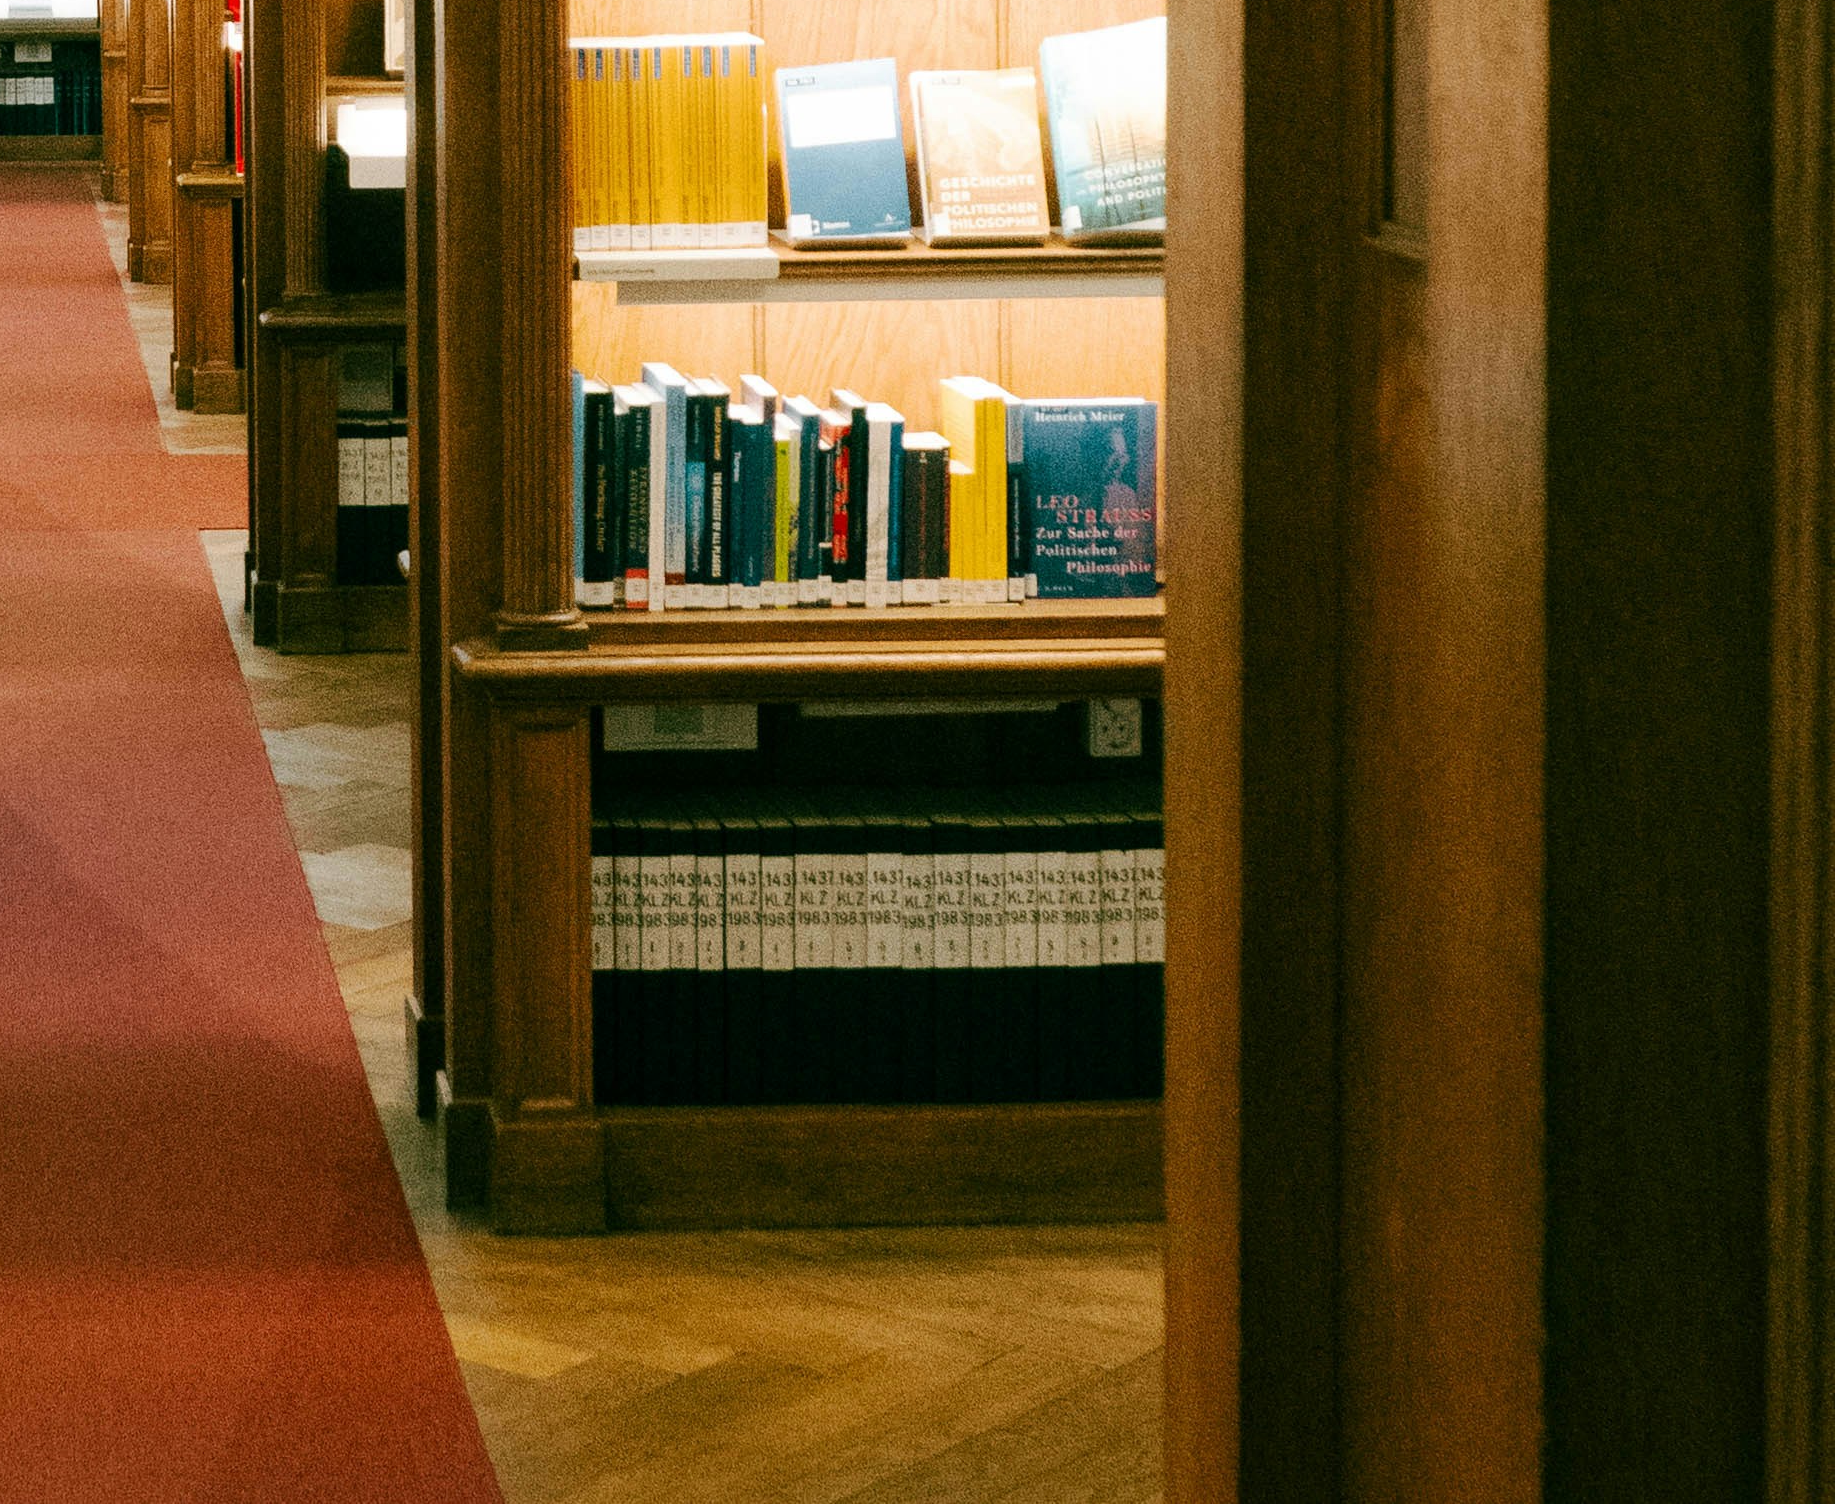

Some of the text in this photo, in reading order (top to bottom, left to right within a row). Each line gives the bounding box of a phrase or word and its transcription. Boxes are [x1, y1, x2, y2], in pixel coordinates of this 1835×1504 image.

[939, 174, 1036, 189] GESCHICHTE
[940, 191, 972, 203] DER
[1097, 193, 1124, 207] AND
[1034, 411, 1125, 423] Heinrich Meier
[593, 479, 607, 519] Pecking
[1035, 494, 1080, 509] LEO
[1055, 508, 1153, 524] STRAUSS
[711, 472, 722, 578] THE GREATEST OF ALL PLAGUES
[1035, 525, 1139, 540] Zur Sache der
[1035, 544, 1118, 557] Politischen
[1065, 560, 1153, 577] Philosophie
[730, 889, 757, 905] KLZ
[765, 891, 793, 907] KLZ
[799, 889, 828, 905] KLZ
[836, 891, 865, 906] KLZ
[870, 890, 899, 905] KLZ
[904, 893, 933, 910] KLZ
[937, 890, 965, 906] KLZ
[972, 891, 1000, 907] KLZ
[1006, 890, 1035, 904] KLZ
[1069, 890, 1097, 905] KLZ
[1101, 887, 1130, 903] KLZ
